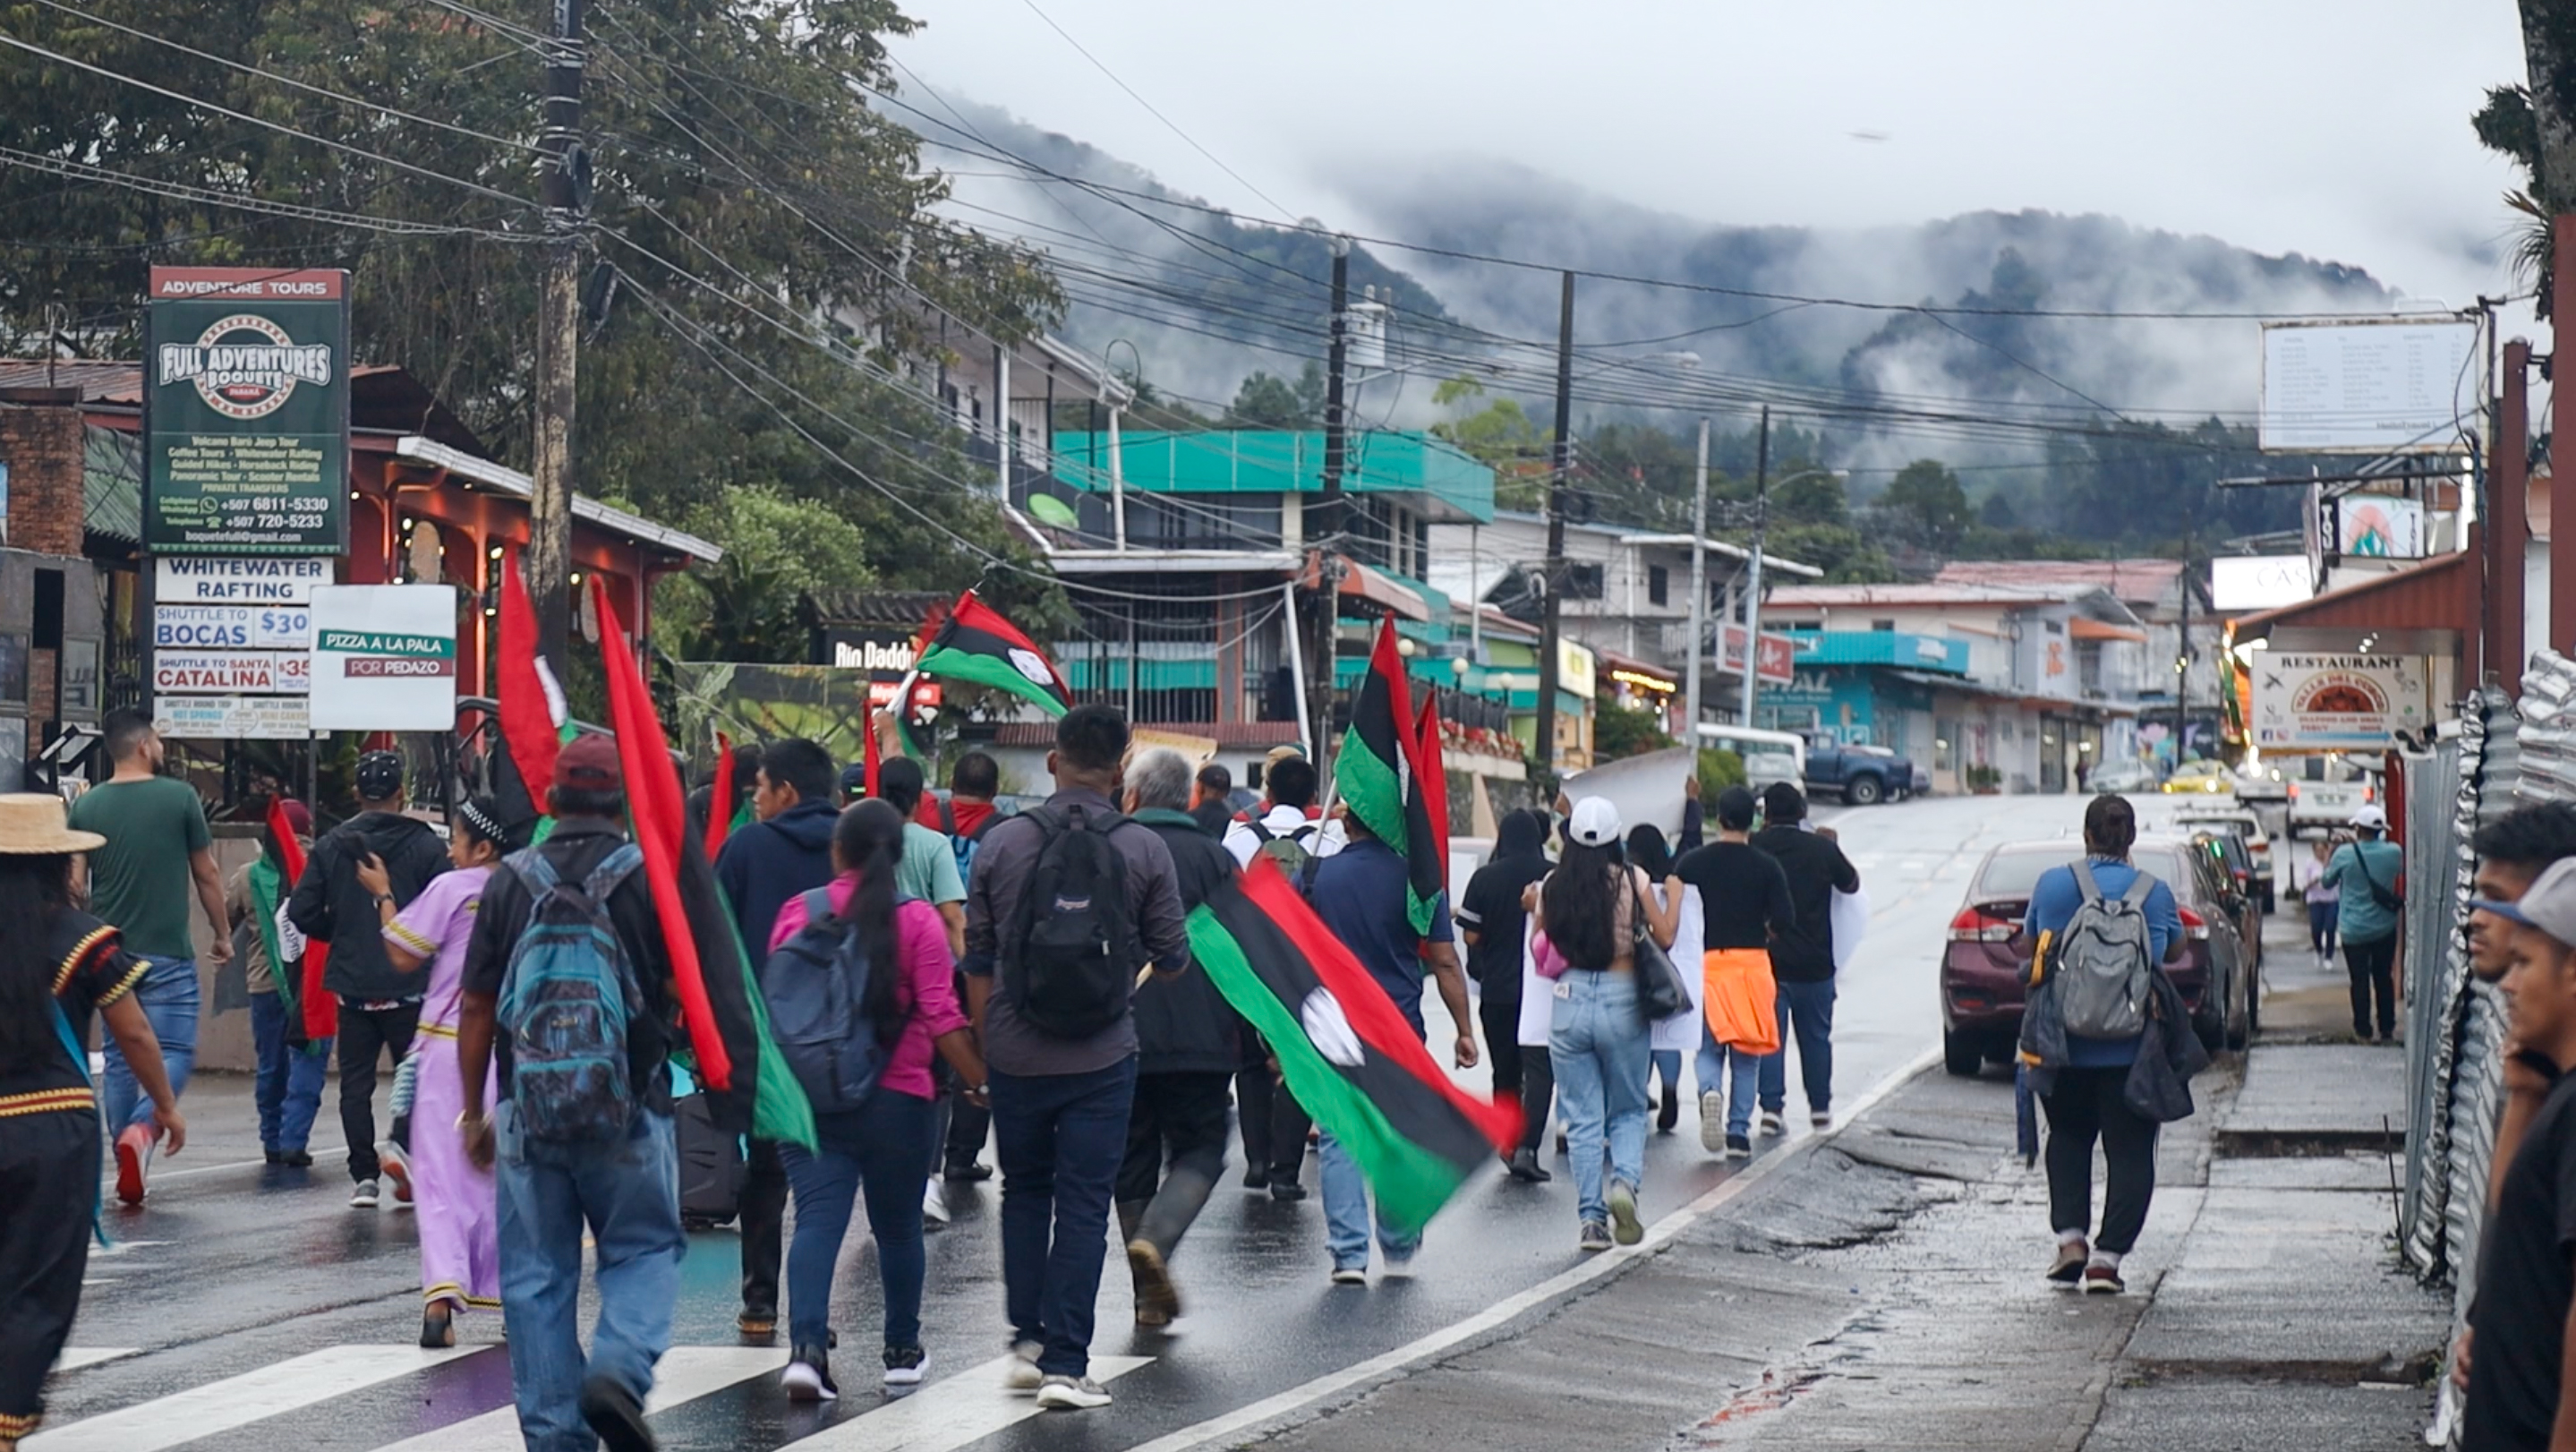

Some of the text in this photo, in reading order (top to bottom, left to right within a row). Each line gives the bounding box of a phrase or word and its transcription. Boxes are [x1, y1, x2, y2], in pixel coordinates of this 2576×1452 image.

[162, 280, 328, 295] ADVENTURE TOURS
[162, 346, 328, 383] FULL ADVENTURES
[208, 370, 284, 389] BOQUETE
[191, 435, 229, 447] Volcano
[278, 436, 300, 447] Tour
[167, 447, 323, 460] Coffee Tours Whitewater Rafting
[171, 458, 320, 472] Guided Hikes Horseback Riding
[169, 471, 220, 481] Panoramic
[221, 472, 243, 482] Tour
[200, 483, 289, 493] PRIVATE TRANSFERS
[220, 499, 251, 511] +507
[252, 497, 328, 511] 6811-5330
[226, 516, 255, 527] +507
[257, 514, 324, 528] 720-5233
[169, 559, 322, 577] WHITEWATER
[197, 581, 293, 598] RAFTING
[157, 607, 248, 621] SHUTTLE TO
[157, 624, 247, 645] BOCAS
[261, 611, 308, 635] $30
[326, 633, 368, 649] PIZZA
[370, 636, 382, 650] A
[385, 636, 405, 652] LA
[405, 637, 442, 653] PALA
[834, 641, 863, 669] Rin
[158, 658, 209, 668] SHUTTLE
[212, 659, 226, 668] TO
[229, 659, 271, 670] SANTA
[351, 661, 440, 675] POR PEDAZO
[2282, 656, 2404, 670] RESTAURANT
[158, 669, 271, 688] CATALINA
